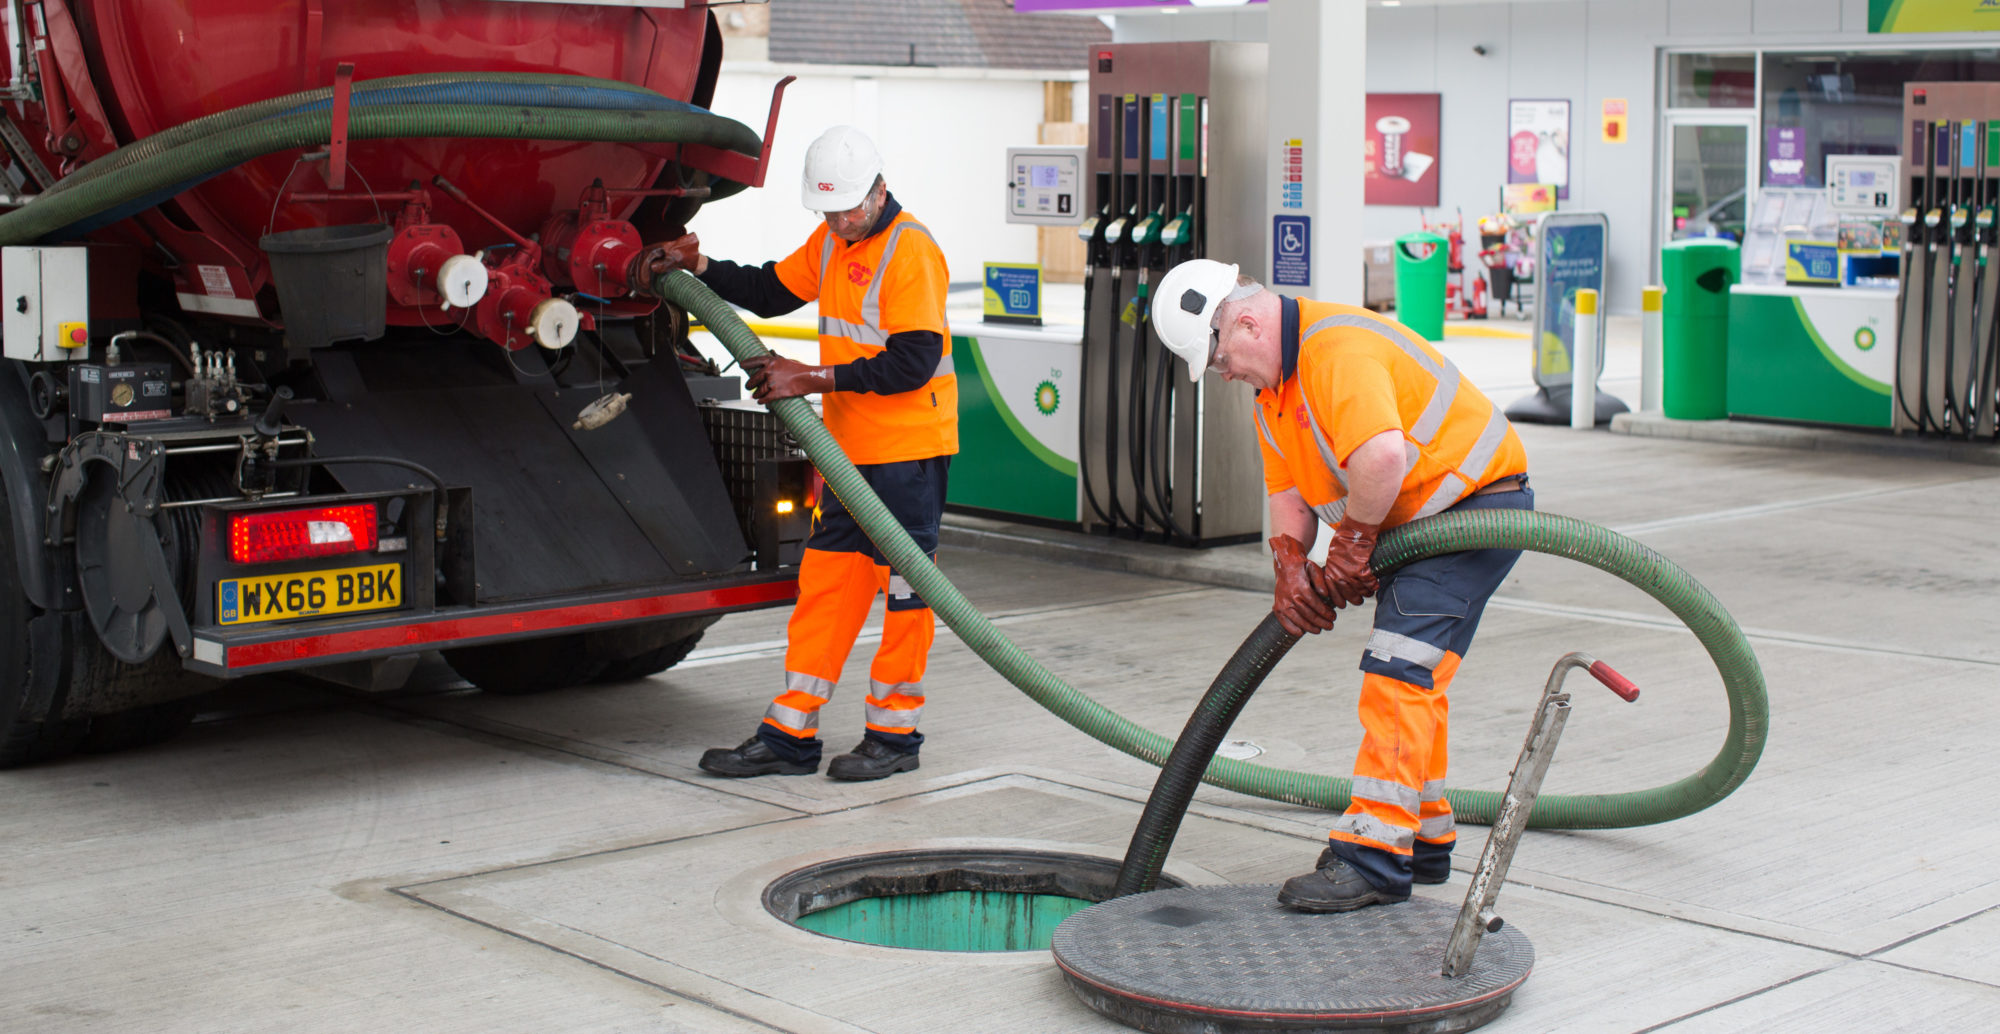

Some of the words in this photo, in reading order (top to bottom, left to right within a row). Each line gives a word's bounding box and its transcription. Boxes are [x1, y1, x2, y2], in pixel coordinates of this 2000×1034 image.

[1050, 366, 1063, 380] bp
[242, 577, 326, 617] WX66
[336, 569, 396, 607] BBK
[223, 609, 237, 619] GB
